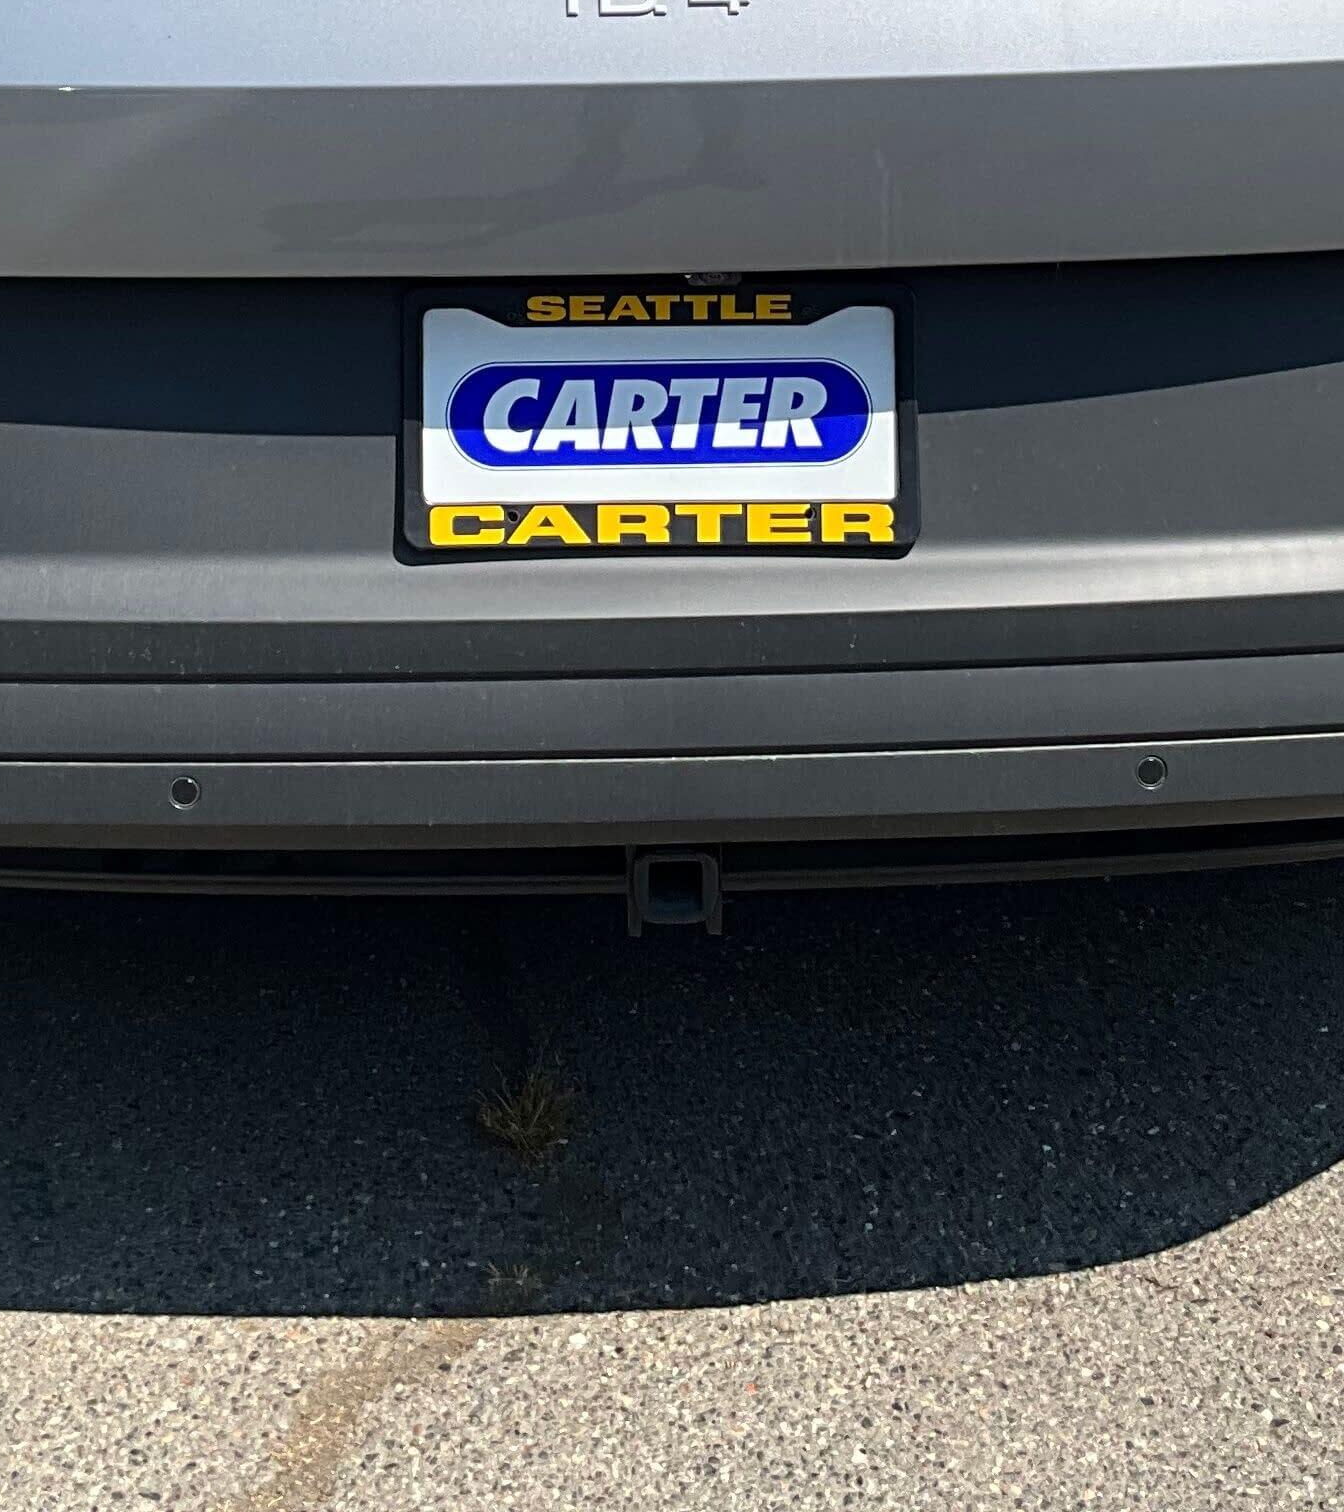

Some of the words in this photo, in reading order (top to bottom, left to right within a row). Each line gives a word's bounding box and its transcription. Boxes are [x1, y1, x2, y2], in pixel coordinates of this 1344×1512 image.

[526, 294, 792, 322] SEATTLE
[483, 376, 827, 454] CARTER
[429, 502, 895, 547] CARTER
